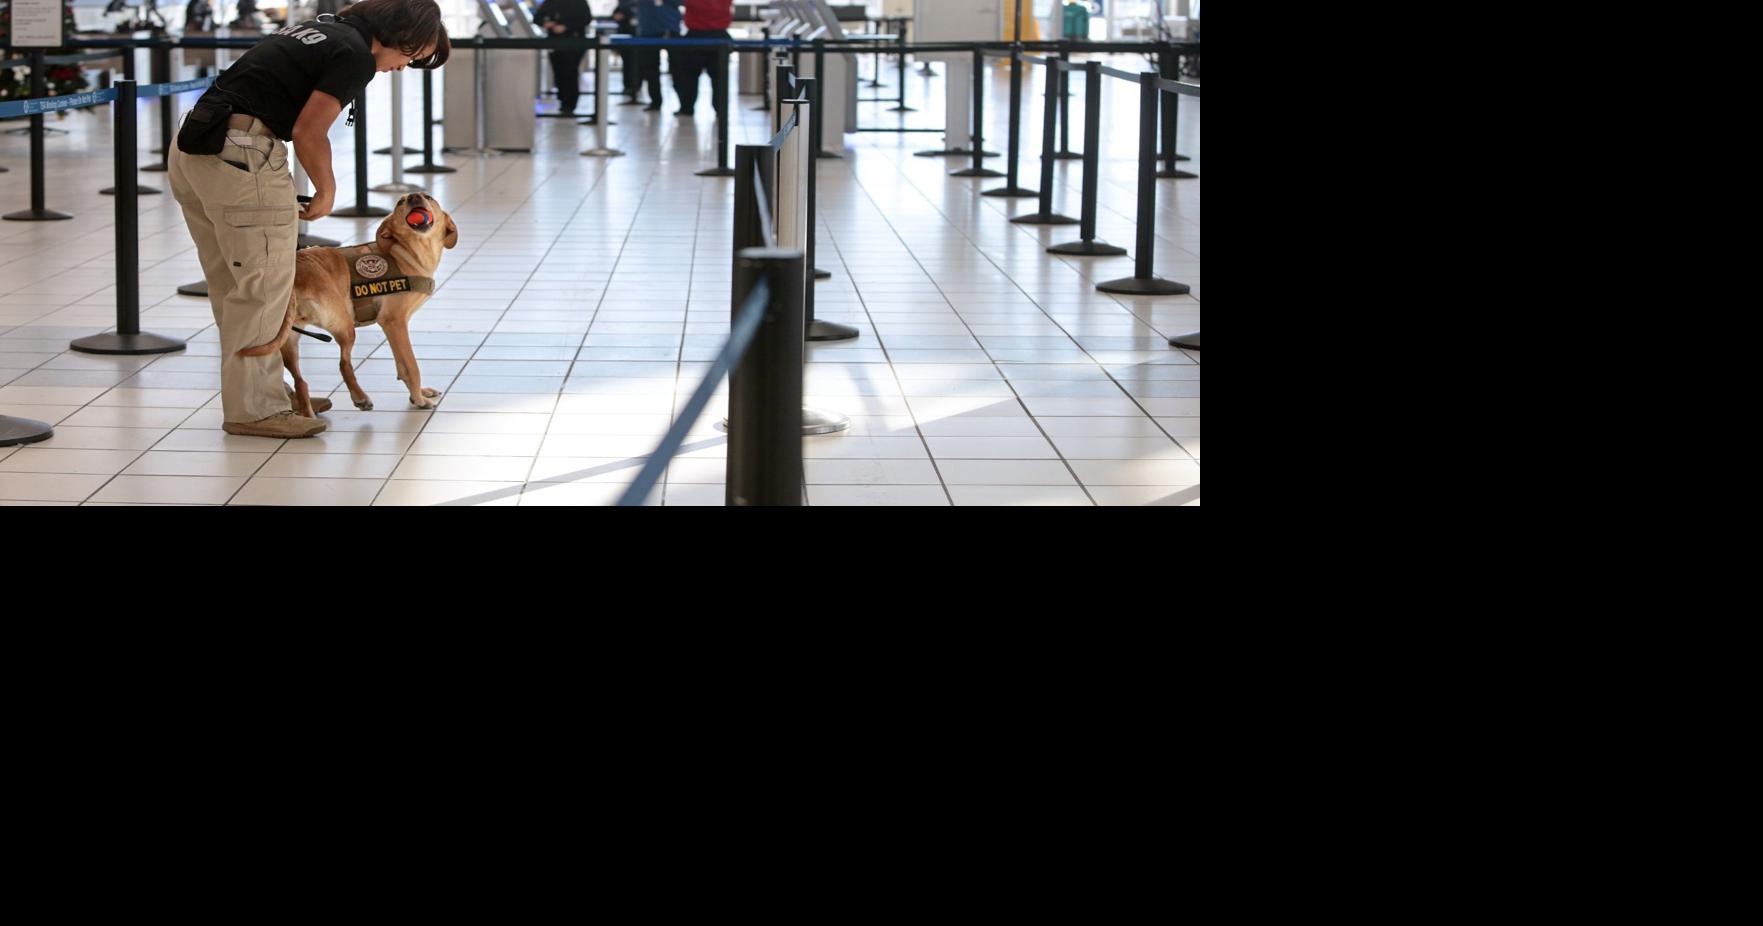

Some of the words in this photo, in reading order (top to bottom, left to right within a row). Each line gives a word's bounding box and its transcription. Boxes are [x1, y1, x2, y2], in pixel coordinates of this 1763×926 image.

[291, 28, 327, 45] K9
[355, 285, 368, 296] DO
[369, 282, 387, 294] NOT
[389, 279, 406, 291] PET
